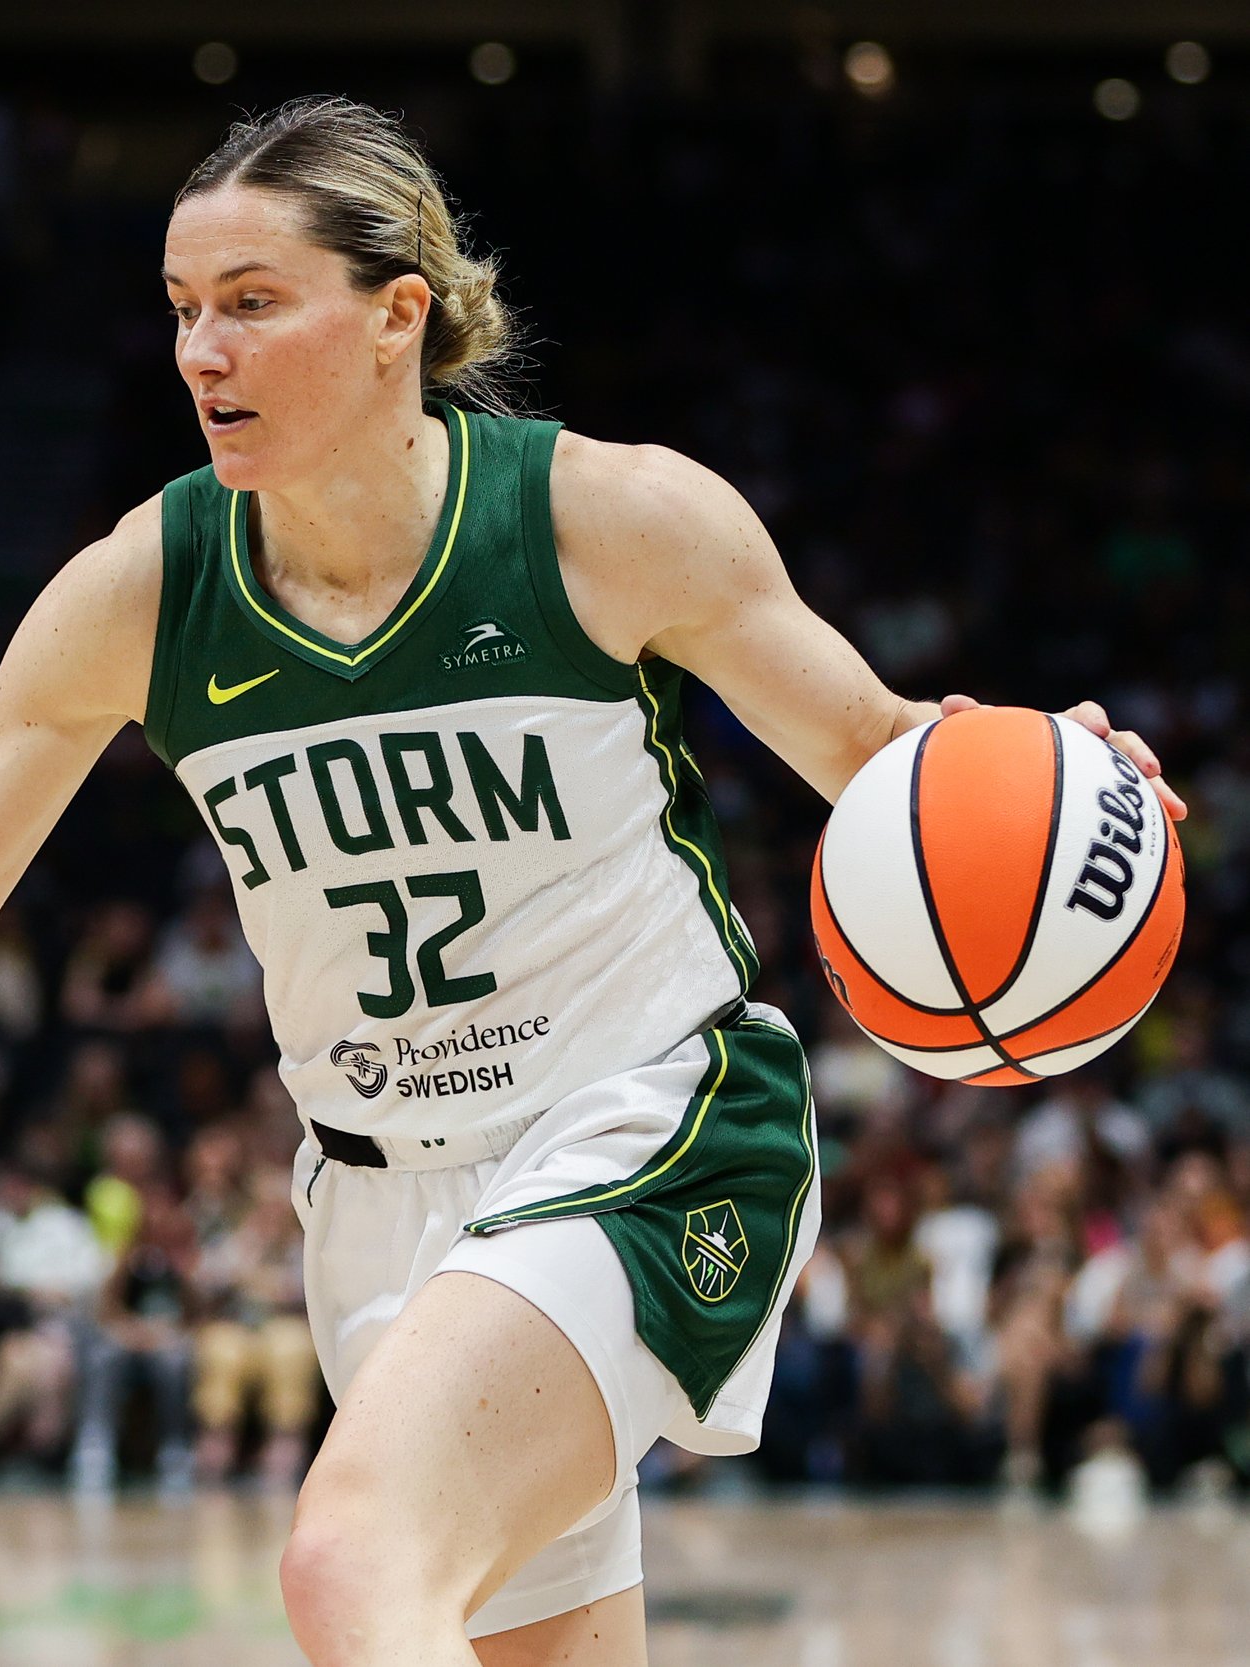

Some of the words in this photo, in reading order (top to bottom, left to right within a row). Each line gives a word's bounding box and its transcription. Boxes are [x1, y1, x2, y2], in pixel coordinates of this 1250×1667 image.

[443, 643, 526, 669] SYMETRA
[203, 732, 572, 890] STORM
[1065, 740, 1145, 922] Wilso
[323, 869, 497, 1019] 32
[393, 1015, 550, 1067] Providence
[396, 1062, 514, 1098] SWEDISH
